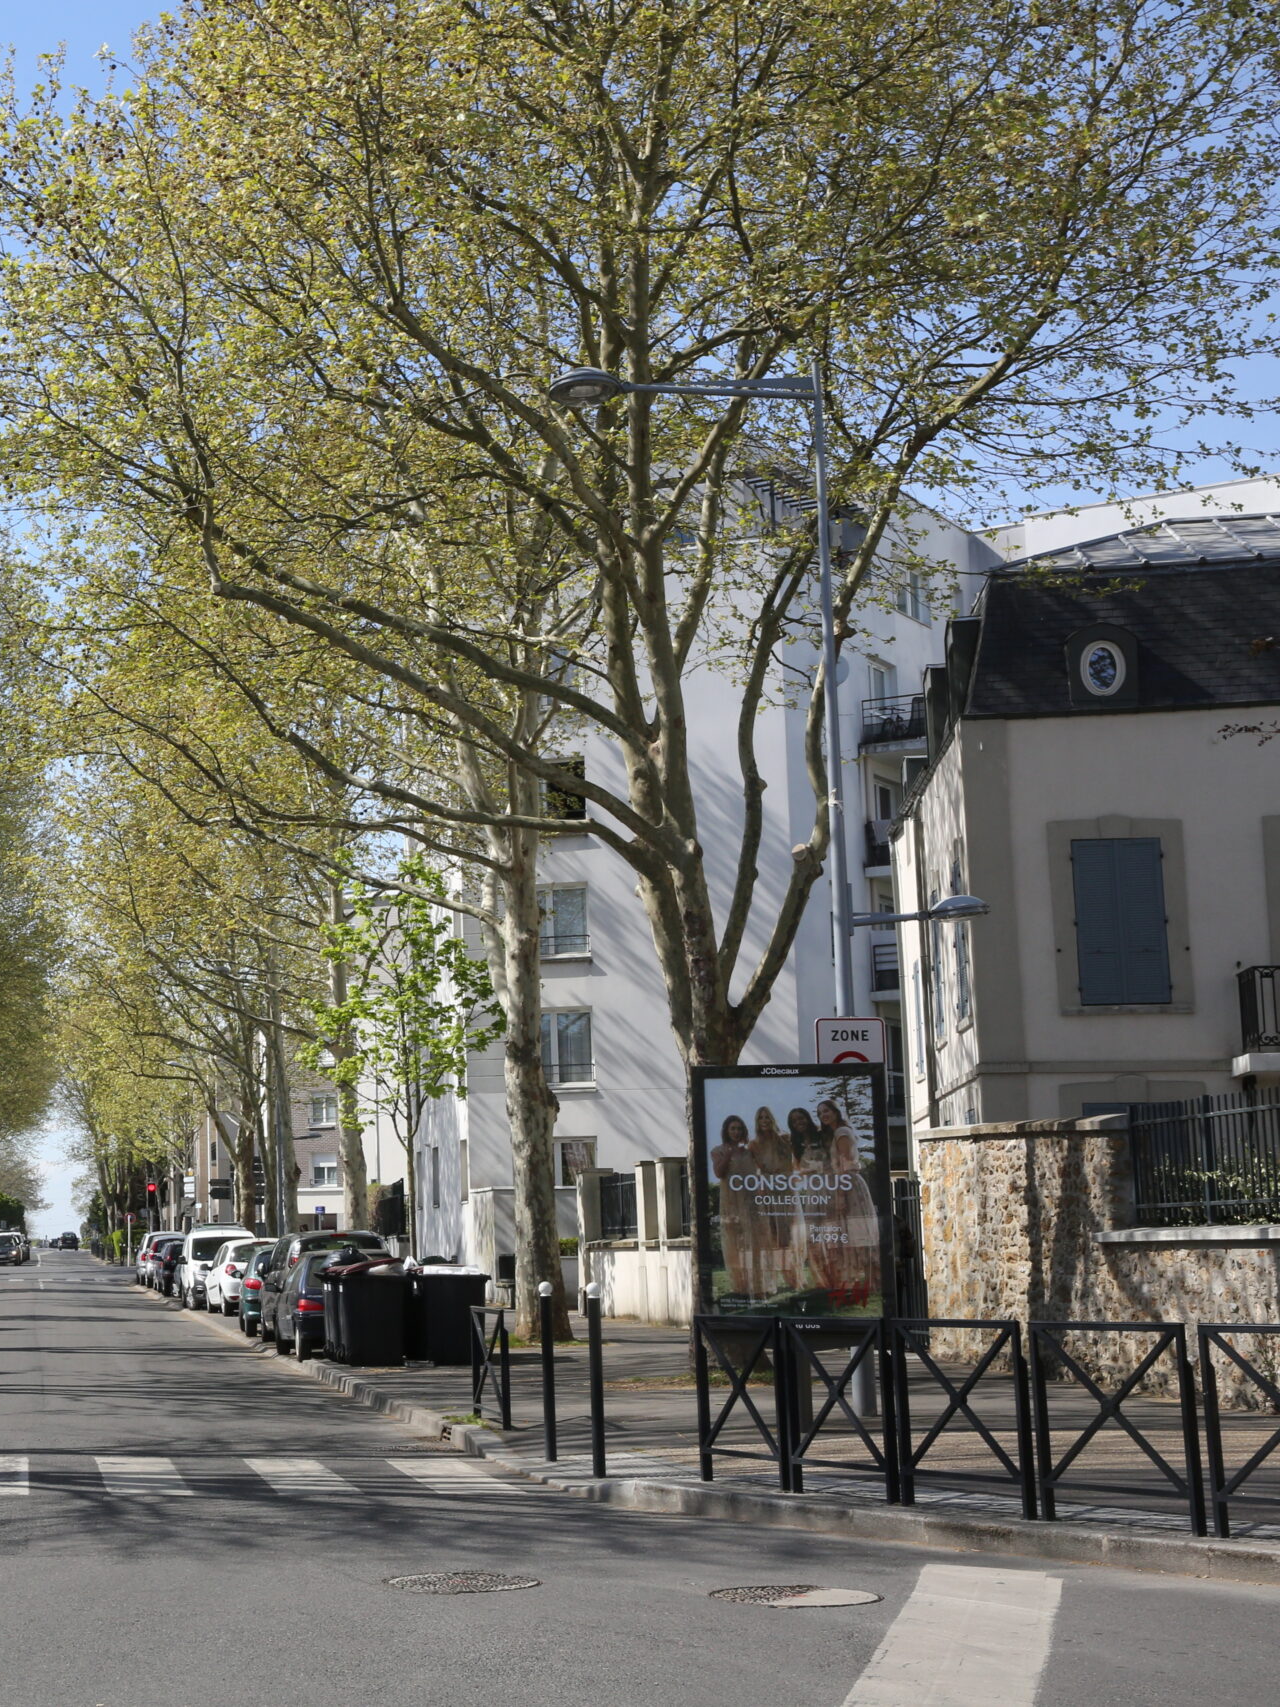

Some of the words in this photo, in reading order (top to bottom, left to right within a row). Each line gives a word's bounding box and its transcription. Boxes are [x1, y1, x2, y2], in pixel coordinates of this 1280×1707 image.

[831, 1030, 869, 1041] ZONE
[761, 1067, 799, 1075] JCDecaux
[729, 1174, 853, 1191] CONSCIOUS
[809, 1224, 842, 1232] Pantalon
